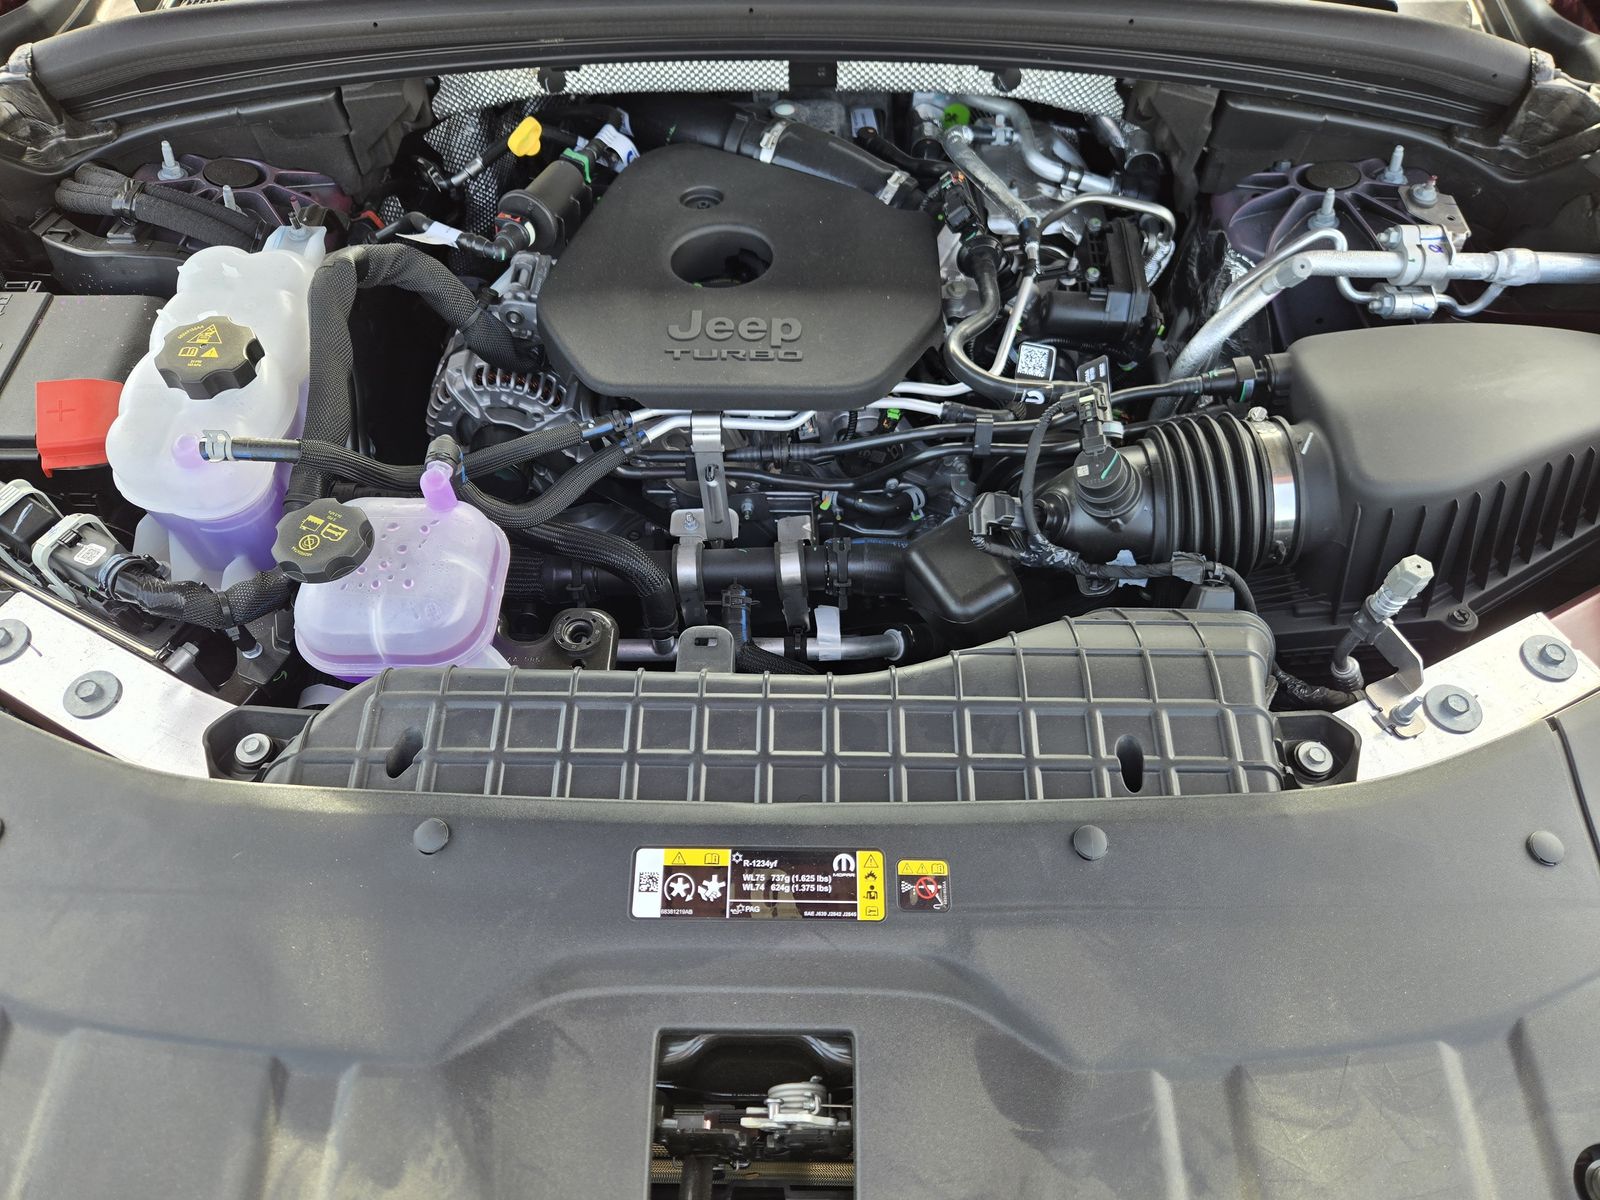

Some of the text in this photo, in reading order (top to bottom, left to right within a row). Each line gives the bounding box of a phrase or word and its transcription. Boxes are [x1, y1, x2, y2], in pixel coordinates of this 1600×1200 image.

[667, 310, 802, 349] Jeep
[664, 349, 804, 362] TURBO
[743, 859, 778, 868] R-1234yf
[771, 874, 790, 883] 737g
[791, 874, 815, 883] (1.625
[816, 874, 832, 883] lbs)
[770, 884, 790, 893] 624g
[791, 884, 815, 893] (1.375
[816, 884, 832, 893] lbs)
[745, 905, 760, 913] PAG
